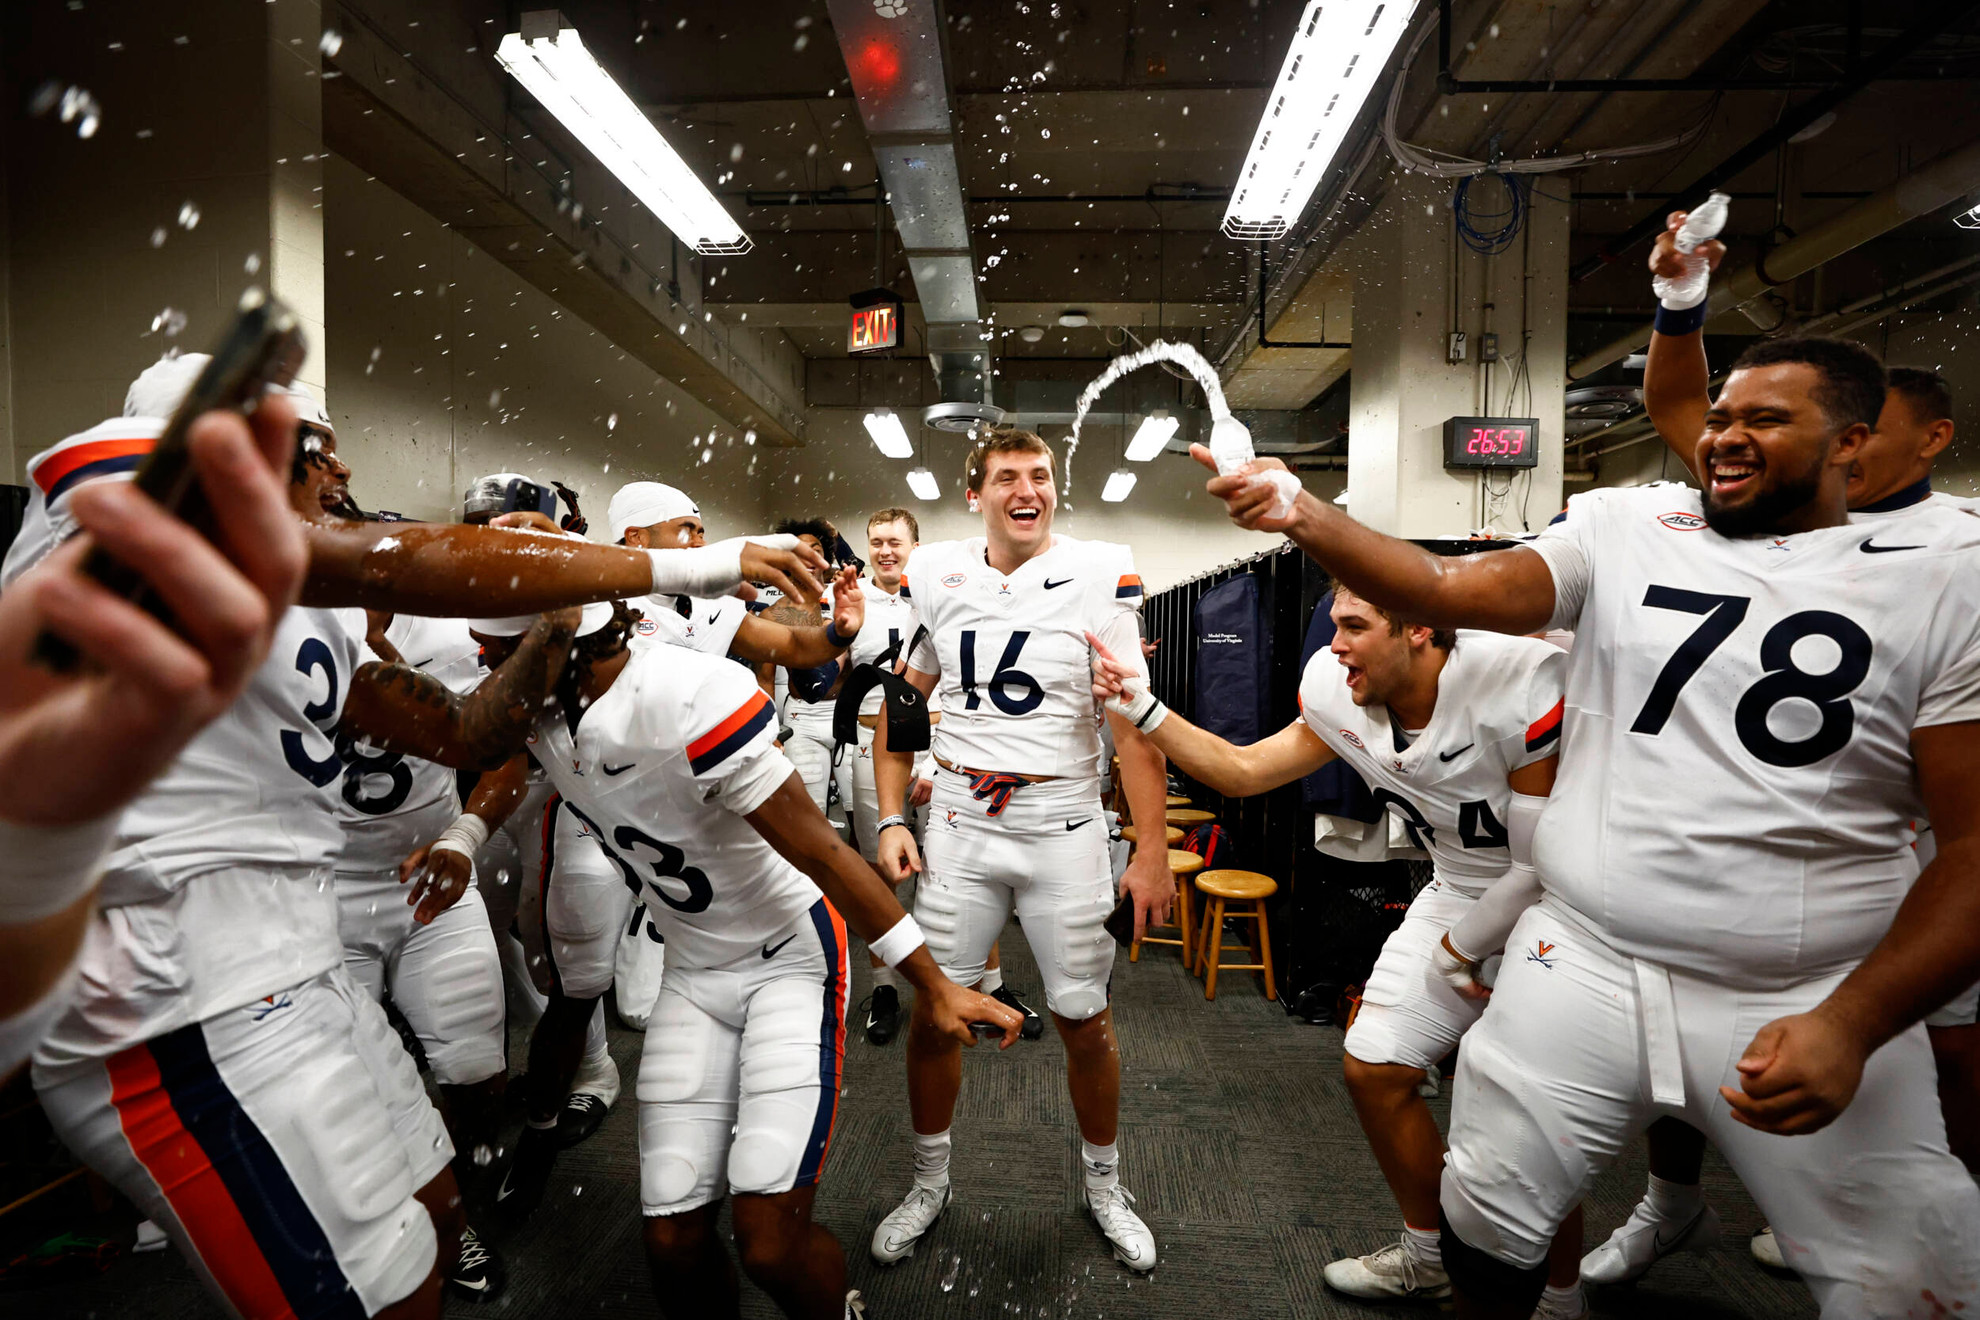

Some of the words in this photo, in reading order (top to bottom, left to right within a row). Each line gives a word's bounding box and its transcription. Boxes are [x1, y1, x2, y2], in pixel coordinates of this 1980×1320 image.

[852, 307, 892, 347] EXIT
[1467, 428, 1525, 455] 26:53
[960, 630, 1045, 716] 16
[1630, 584, 1873, 768] 78
